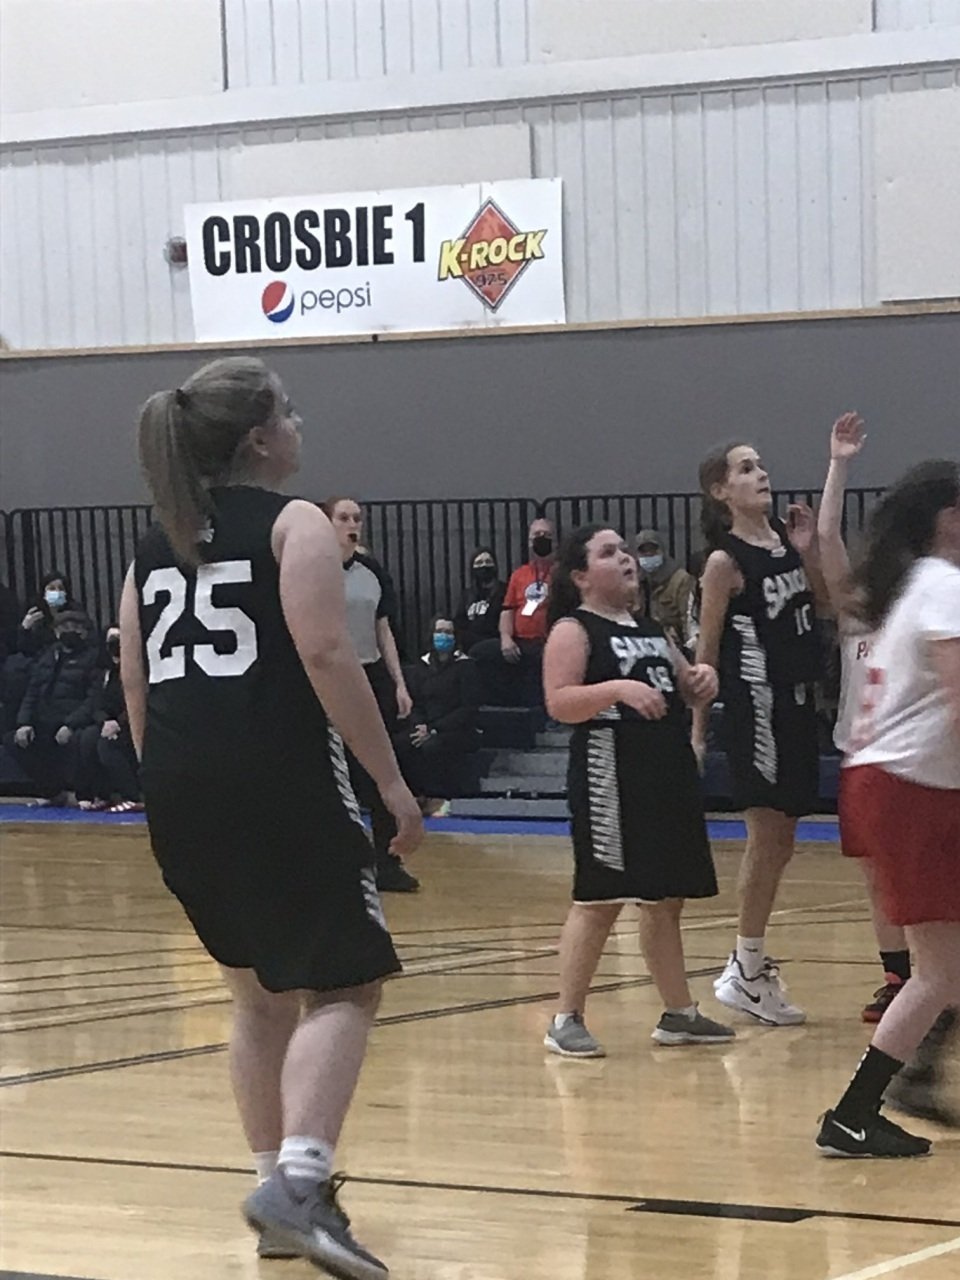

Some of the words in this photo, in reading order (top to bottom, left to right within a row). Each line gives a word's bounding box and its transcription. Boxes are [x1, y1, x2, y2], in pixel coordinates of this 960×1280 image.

[202, 205, 394, 276] CROSBIE
[405, 202, 425, 262] 1
[438, 229, 548, 281] K-ROCK
[300, 282, 372, 315] pepsi
[142, 560, 258, 684] 25
